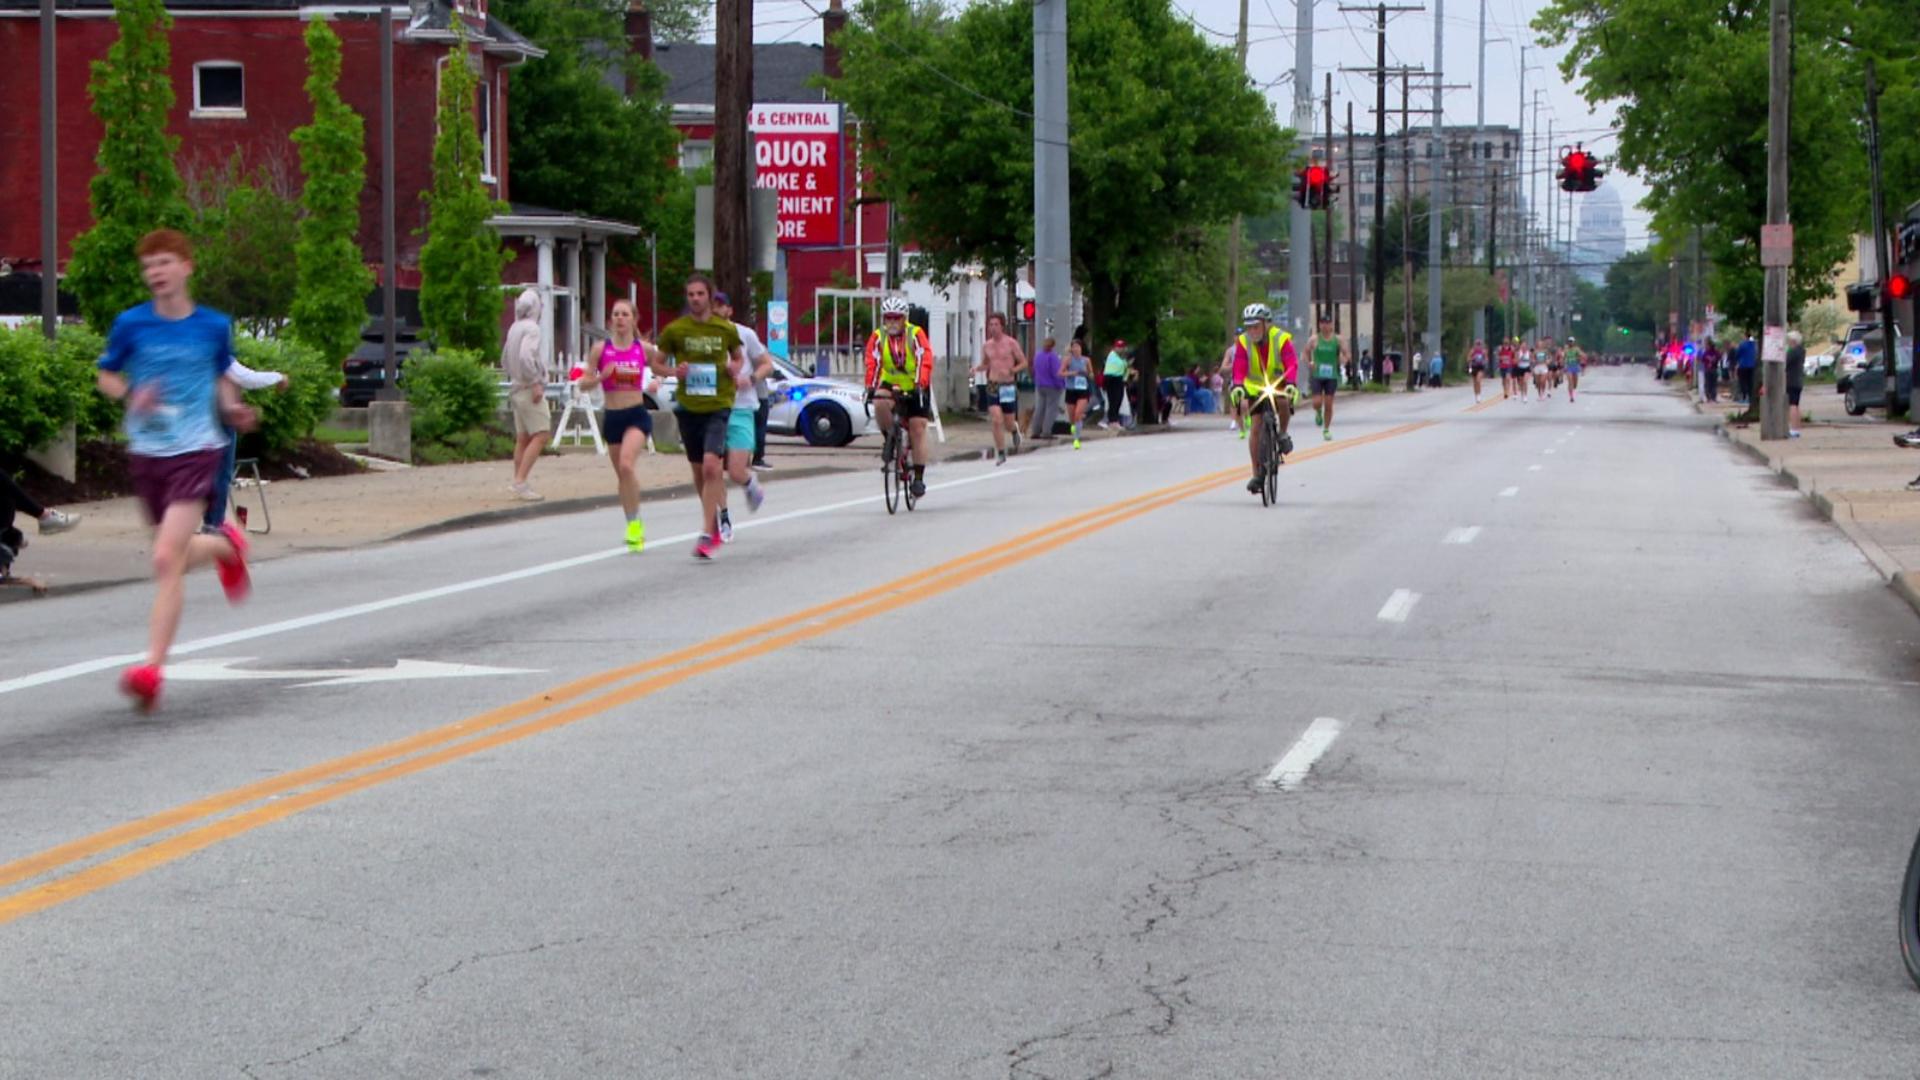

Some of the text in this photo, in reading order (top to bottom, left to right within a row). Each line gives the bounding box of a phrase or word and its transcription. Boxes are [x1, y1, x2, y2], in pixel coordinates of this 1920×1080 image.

[757, 112, 766, 126] &
[770, 112, 830, 126] CENTRAL
[755, 140, 827, 168] QUOR
[805, 172, 817, 190] &
